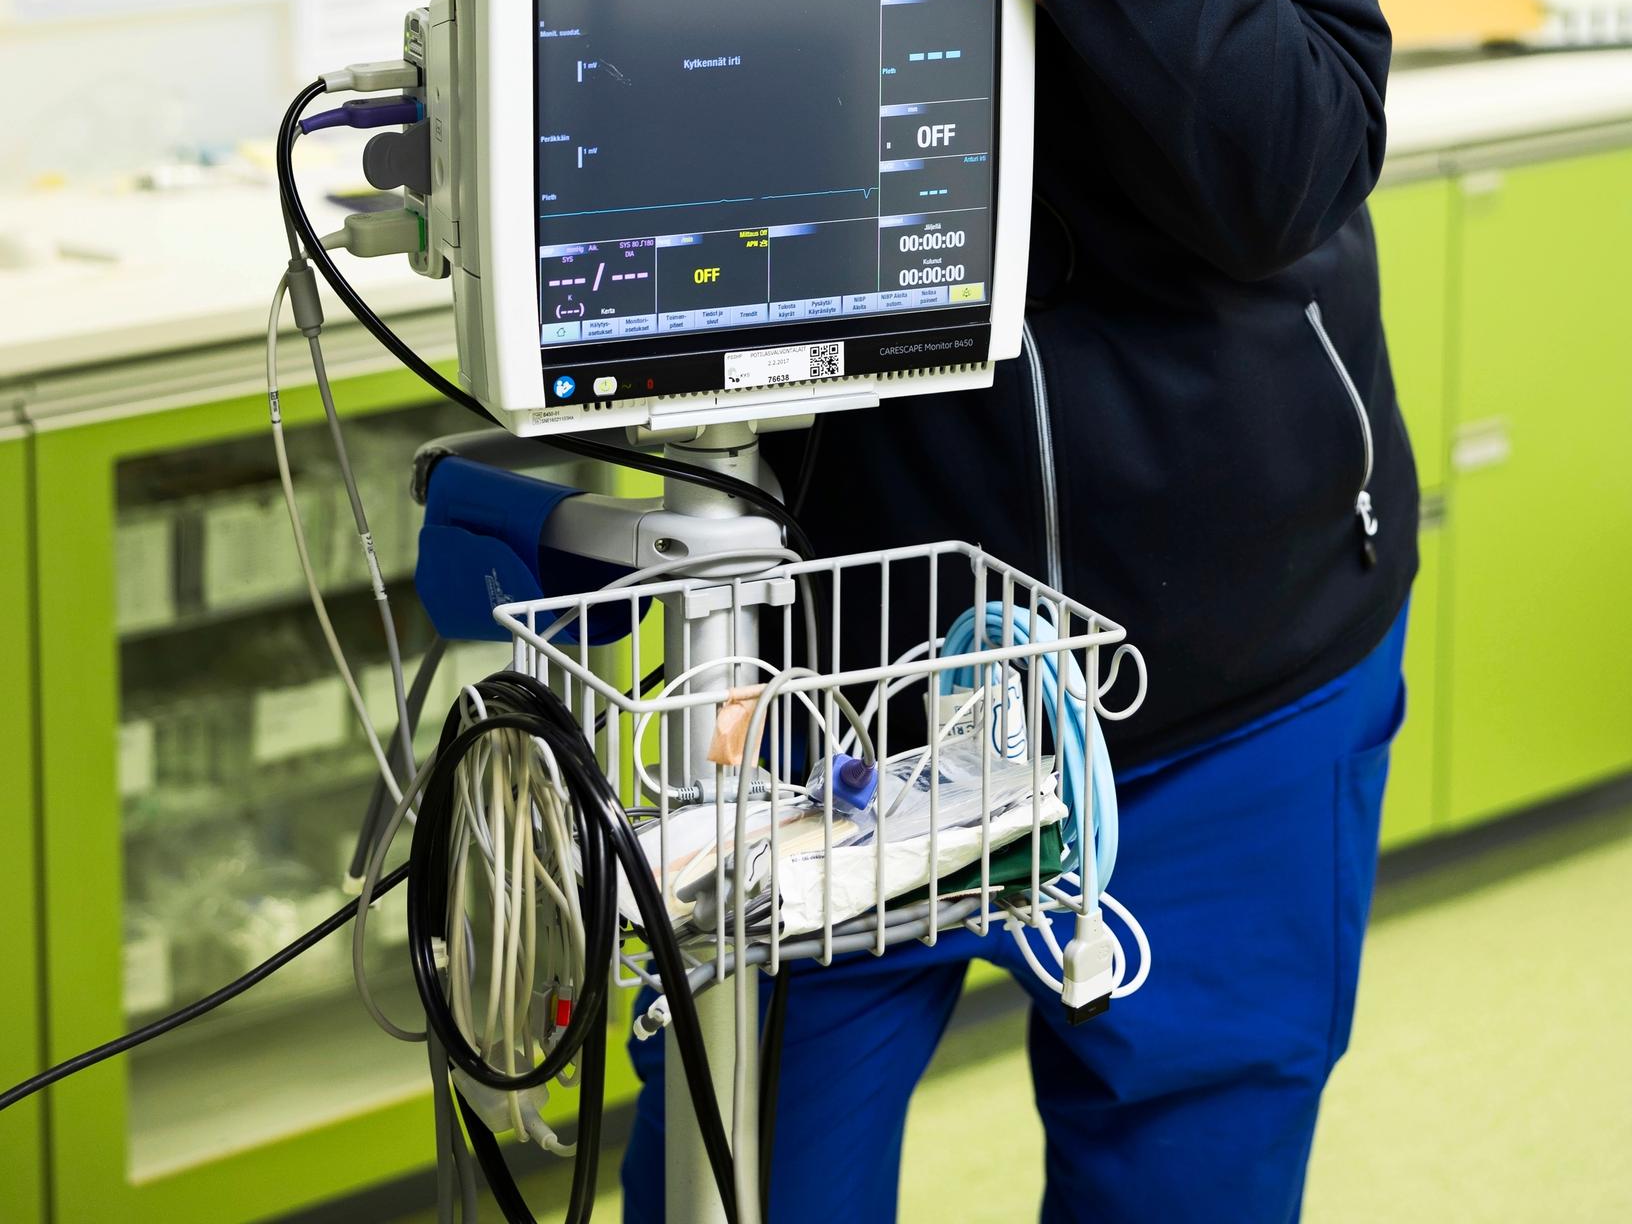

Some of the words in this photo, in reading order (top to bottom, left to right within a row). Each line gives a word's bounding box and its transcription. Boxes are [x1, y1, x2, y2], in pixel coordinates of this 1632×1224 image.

[683, 57, 727, 70] Kytkennät
[728, 55, 741, 66] irti
[916, 123, 956, 148] OFF
[619, 241, 631, 249] SYS
[900, 230, 966, 252] 00:00:00
[561, 256, 574, 264] SYS
[624, 250, 635, 258] DIA
[693, 267, 720, 284] OFF
[899, 264, 965, 286] 00:00:00
[879, 343, 923, 356] CARESCAPE
[924, 340, 953, 352] Monitor
[954, 338, 974, 349] B450
[767, 374, 790, 383] 76638
